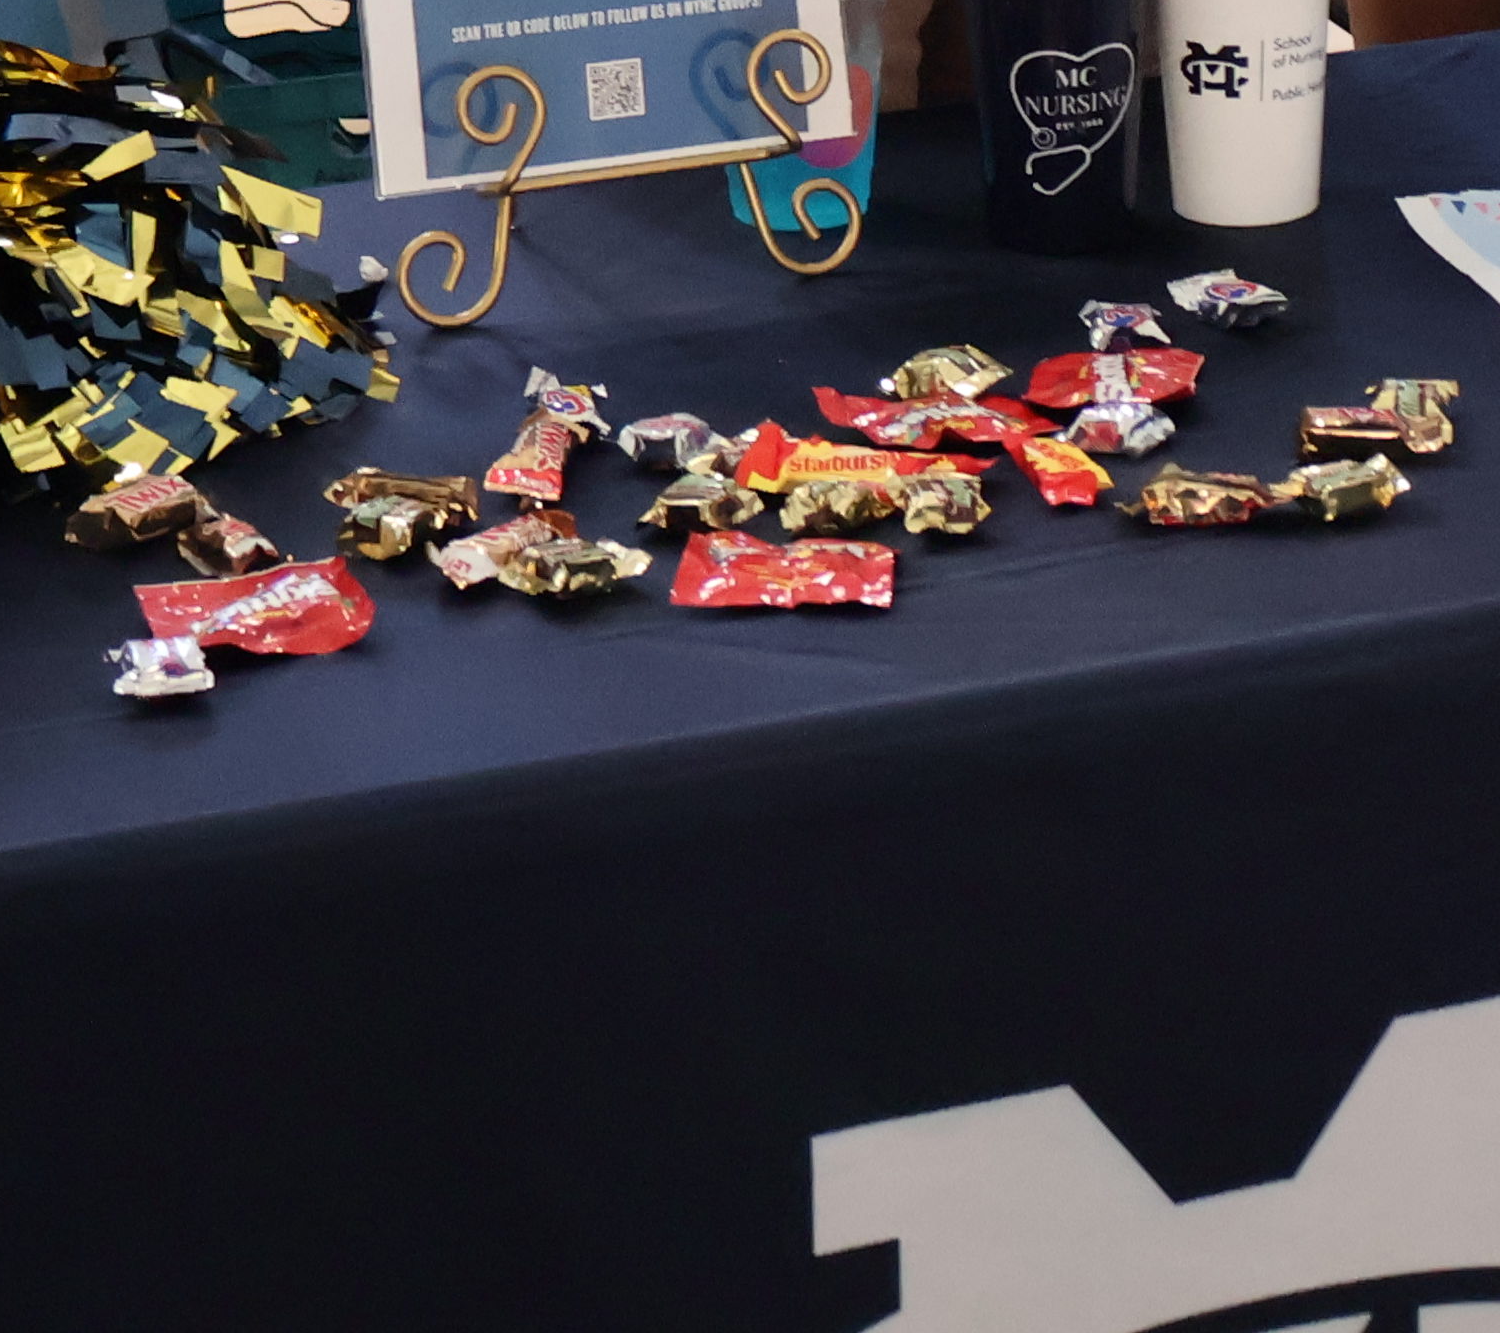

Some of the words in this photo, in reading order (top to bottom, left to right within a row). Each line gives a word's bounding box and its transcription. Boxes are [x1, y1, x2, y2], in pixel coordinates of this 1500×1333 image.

[452, 25, 481, 44] SCAN
[483, 21, 505, 40] THE
[523, 16, 550, 35] CODE
[553, 12, 589, 32] BELOW
[607, 5, 648, 26] FOLLOW
[1056, 66, 1097, 89] MC
[1024, 85, 1128, 117] NURSING
[114, 477, 188, 512] TWIX
